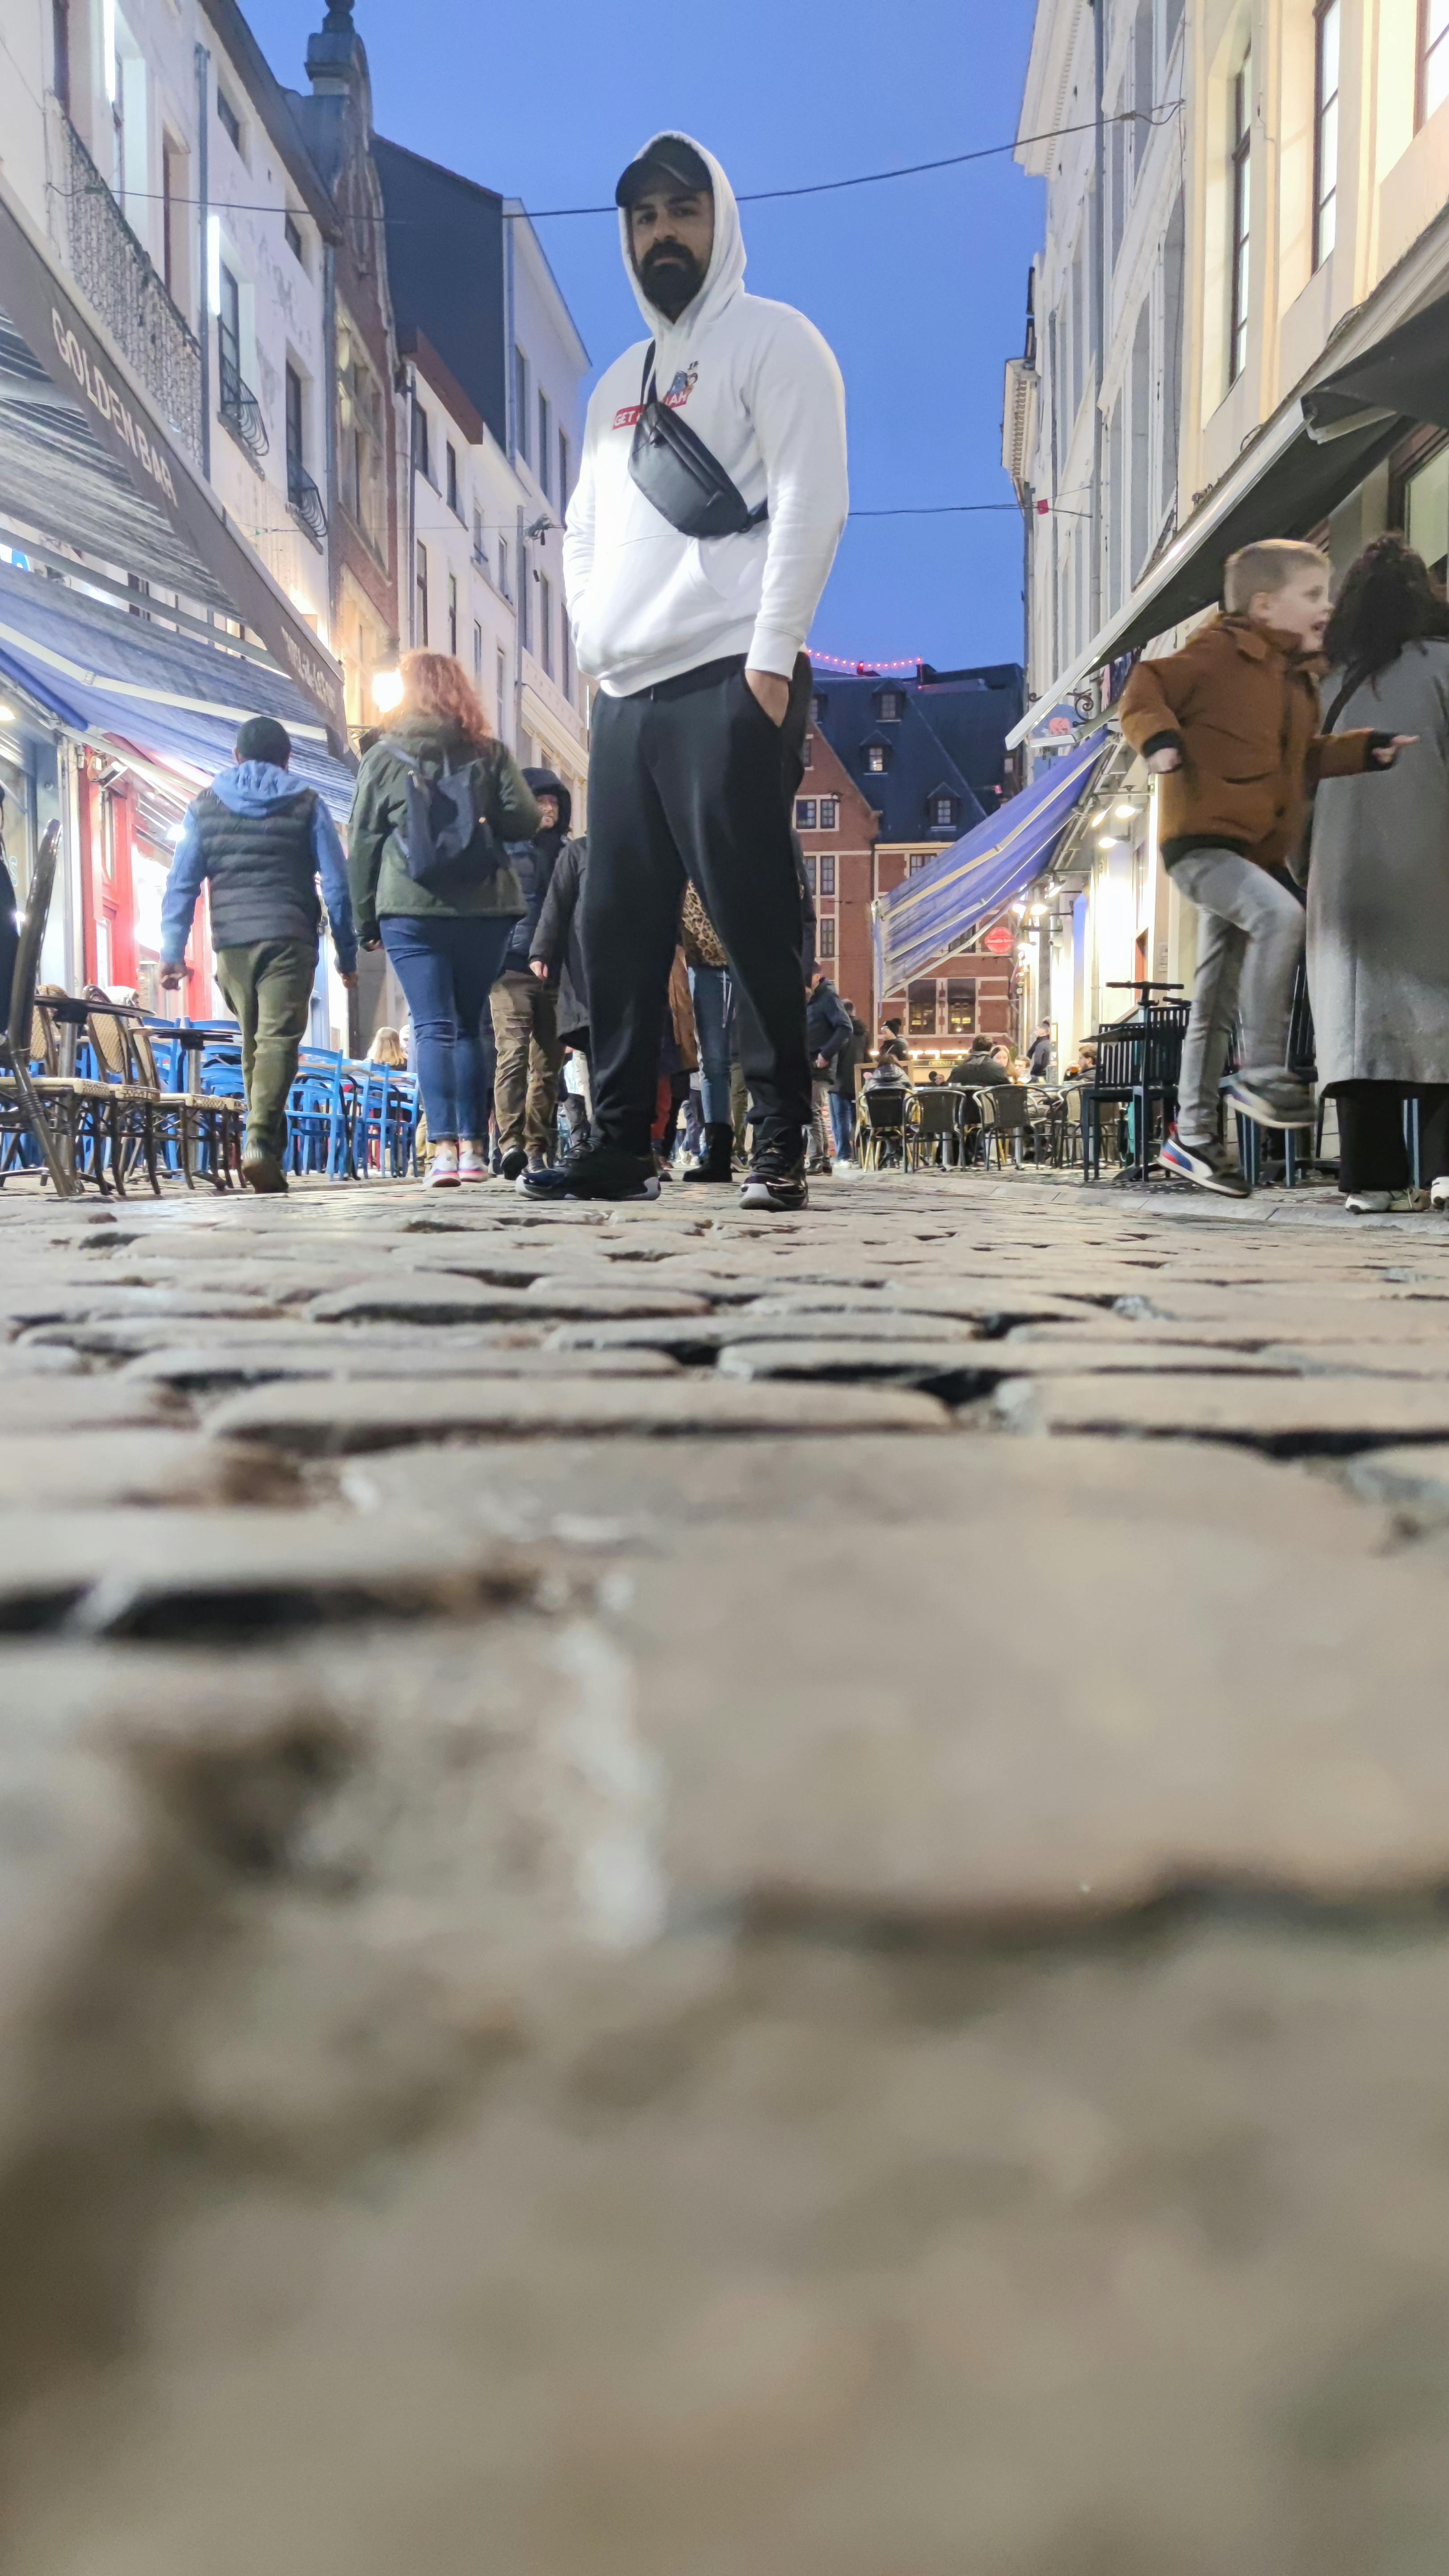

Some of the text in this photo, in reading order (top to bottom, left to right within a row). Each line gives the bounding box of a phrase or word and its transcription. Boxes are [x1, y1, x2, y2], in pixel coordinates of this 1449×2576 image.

[52, 308, 178, 508] GOLDEN BAR
[614, 411, 636, 426] GET
